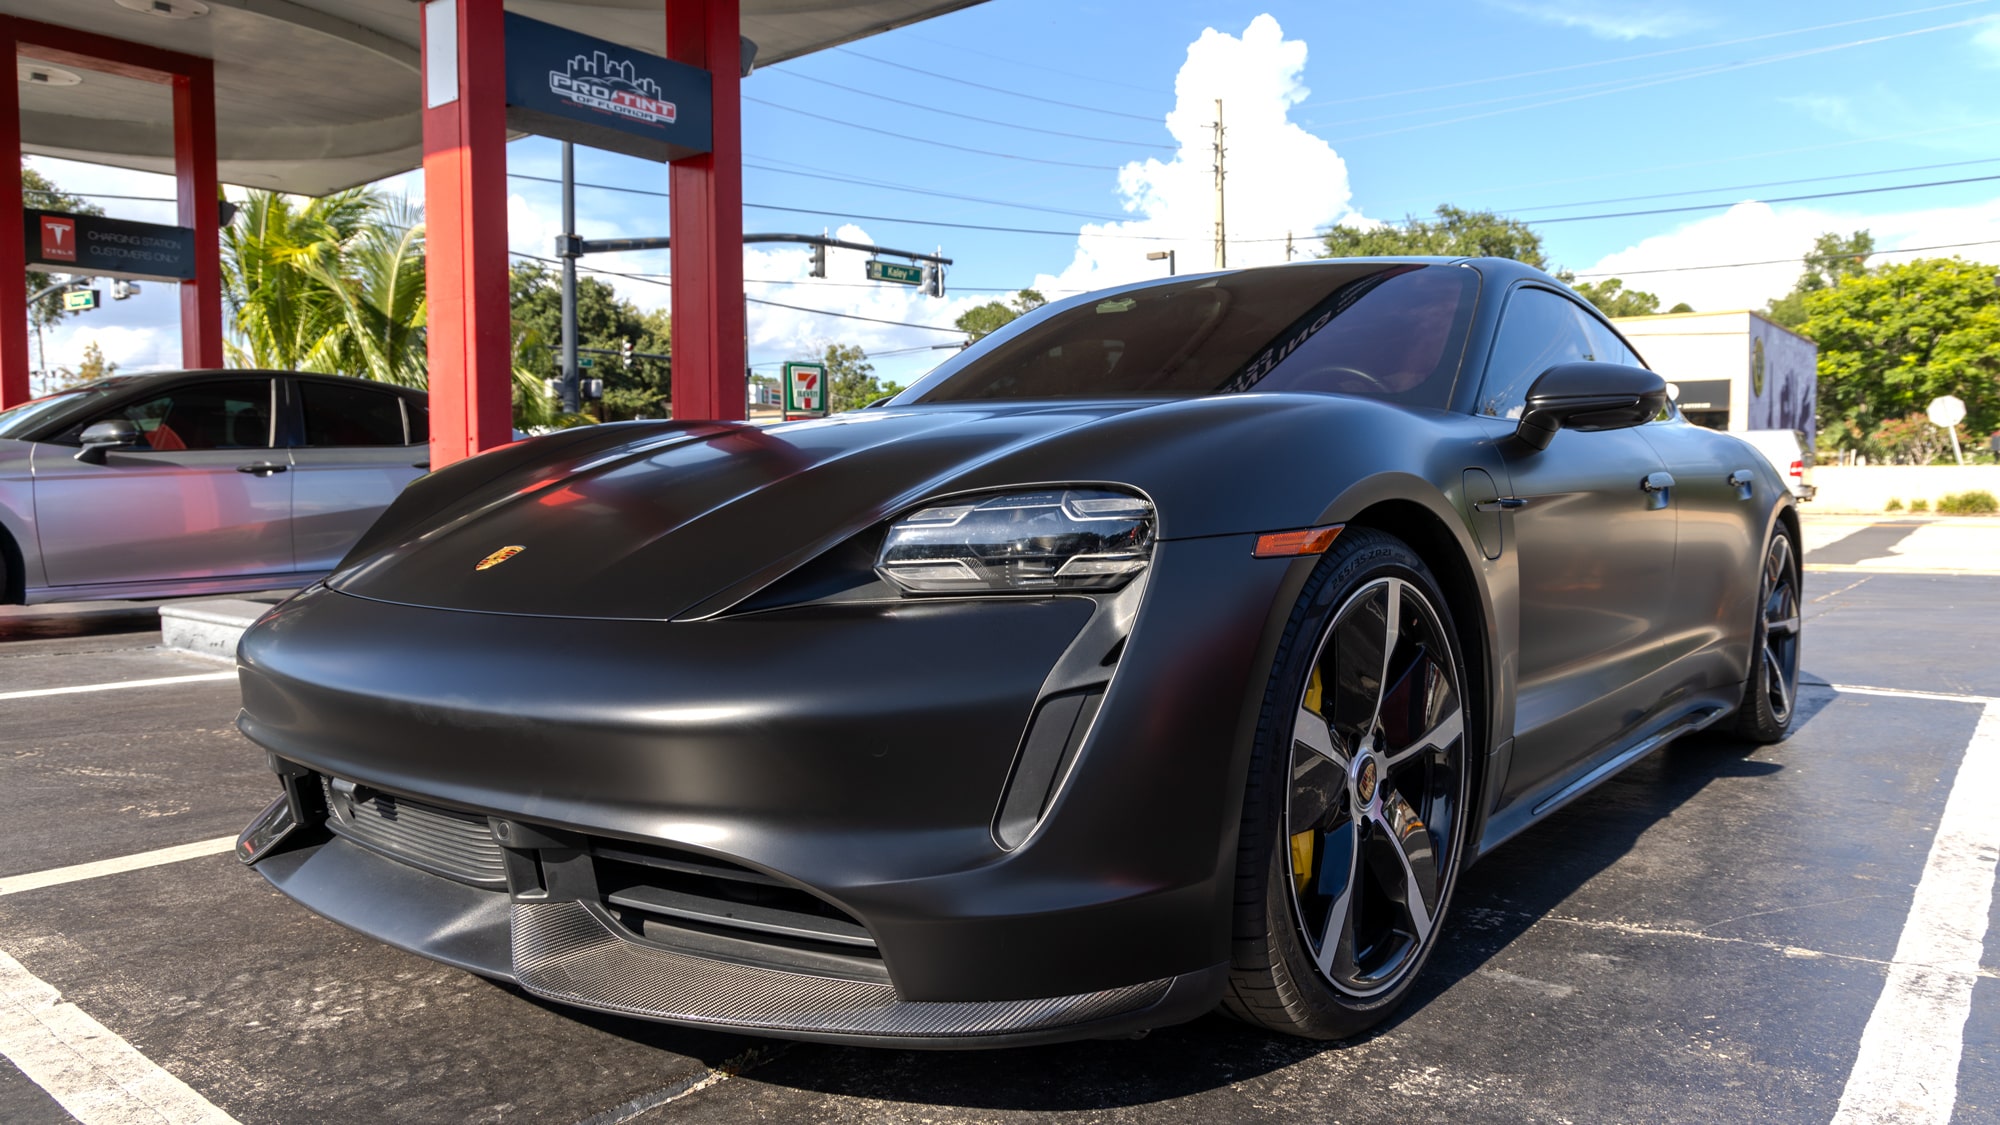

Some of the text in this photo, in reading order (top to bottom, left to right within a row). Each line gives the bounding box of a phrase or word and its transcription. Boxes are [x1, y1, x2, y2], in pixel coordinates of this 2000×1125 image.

[552, 75, 673, 115] PRO TINT
[576, 95, 593, 104] OF
[598, 100, 654, 119] FLORIDA
[88, 230, 181, 250] CHARGING STATION
[46, 248, 73, 256] TESLA
[90, 245, 180, 263] CUSTOMERS ONLY
[888, 266, 907, 280] Kaley
